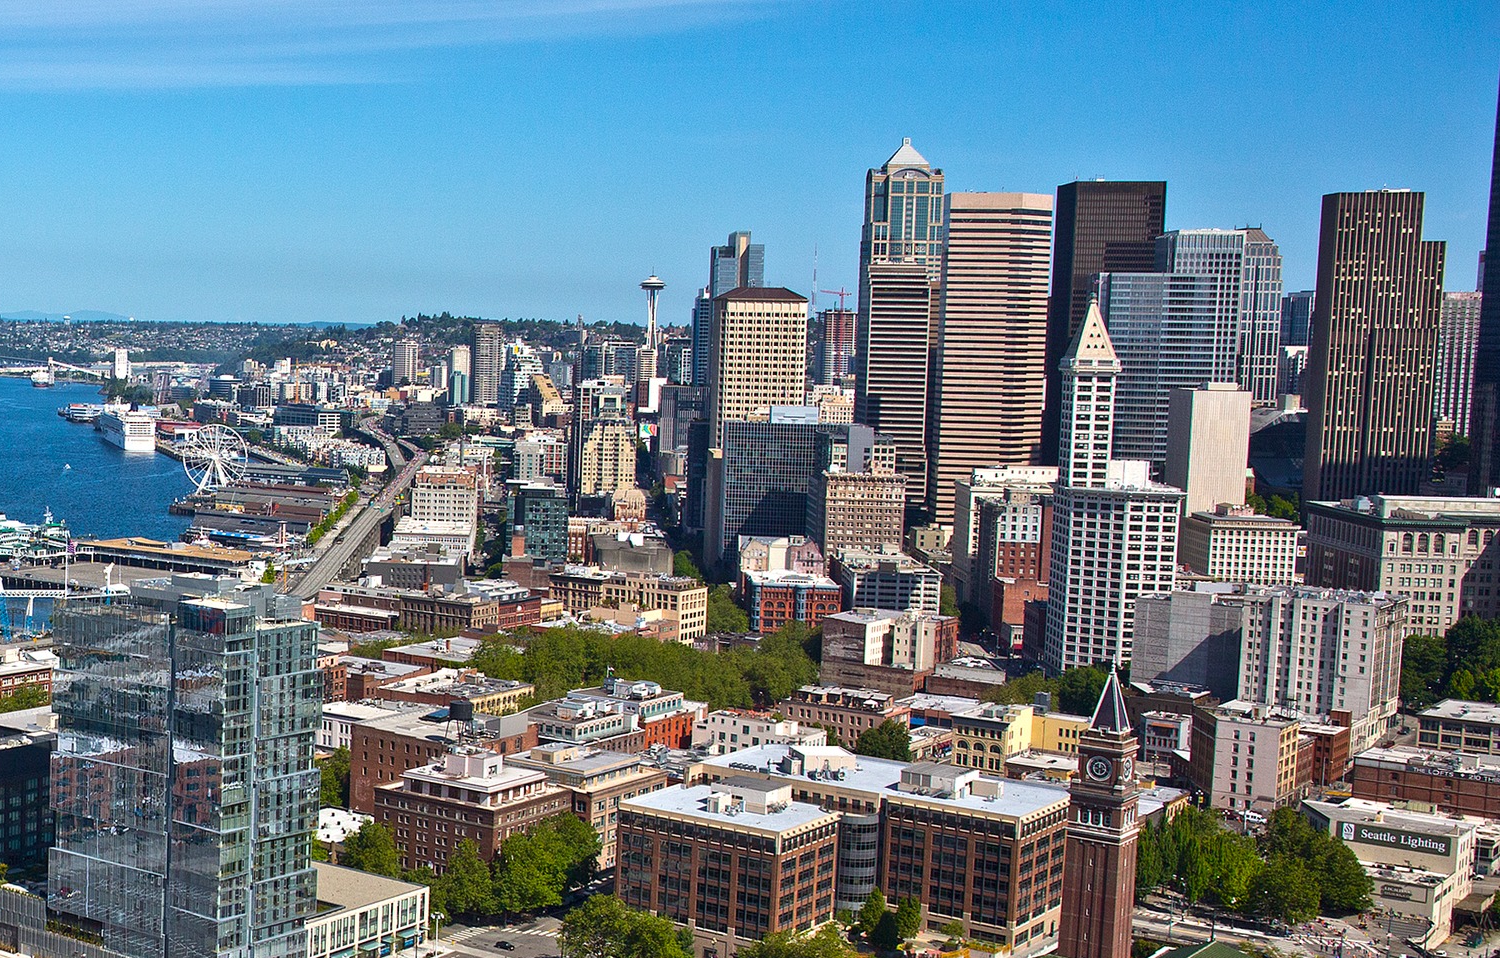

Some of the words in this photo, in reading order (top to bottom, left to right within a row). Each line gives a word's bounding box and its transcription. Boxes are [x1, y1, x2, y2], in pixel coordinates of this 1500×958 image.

[1428, 769, 1454, 778] LOFTS
[1360, 828, 1397, 844] Seattle
[1400, 835, 1446, 853] Lighting
